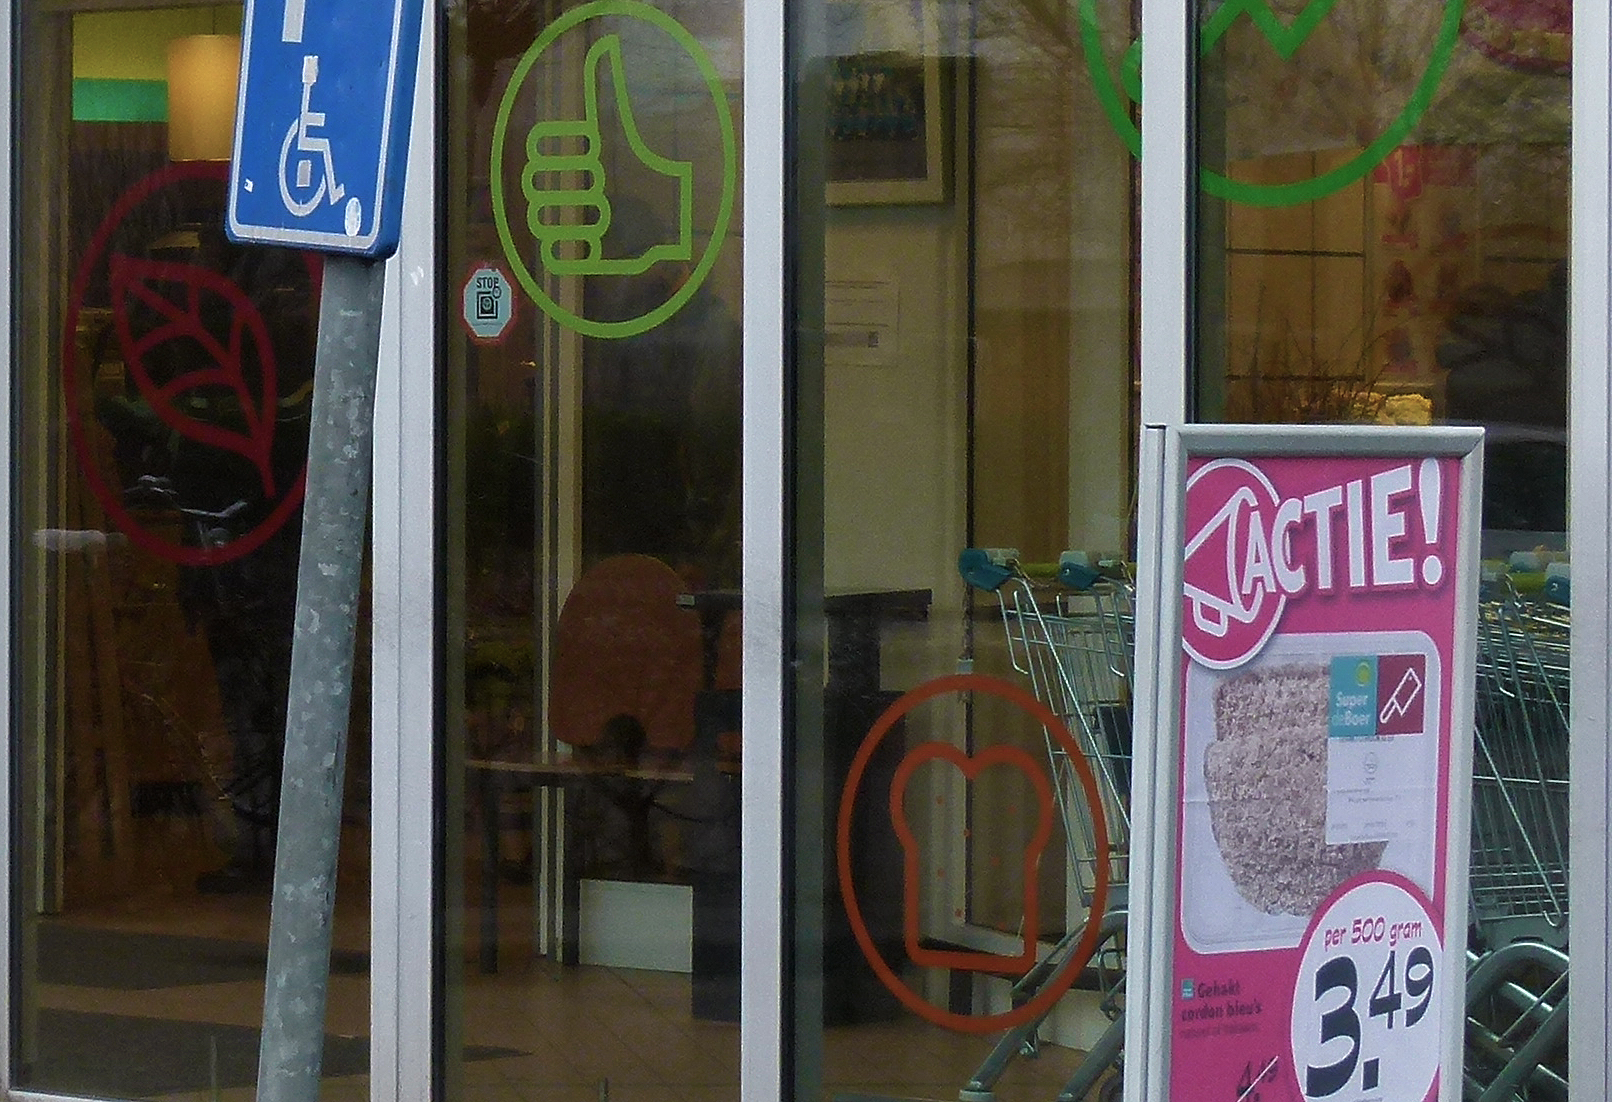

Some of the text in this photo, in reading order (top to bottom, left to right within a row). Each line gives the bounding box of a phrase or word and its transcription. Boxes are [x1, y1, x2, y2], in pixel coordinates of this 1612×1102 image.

[476, 276, 499, 289] STOP
[1241, 457, 1443, 594] ACTIE!
[1336, 691, 1369, 708] Super
[1324, 916, 1423, 952] per 500 gram
